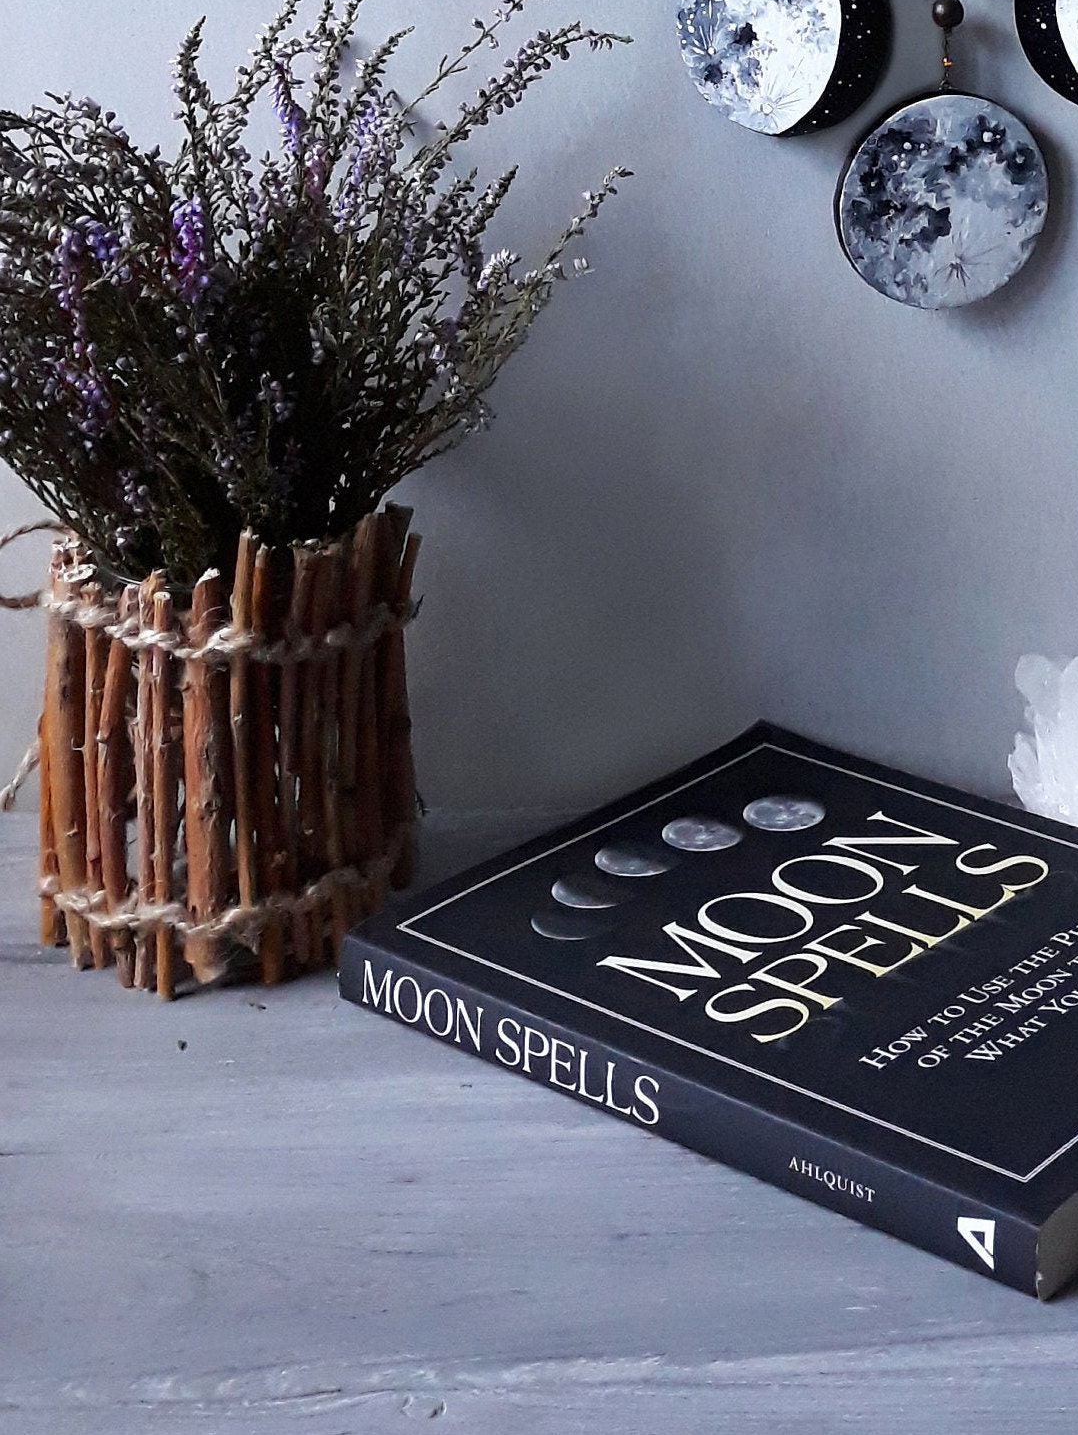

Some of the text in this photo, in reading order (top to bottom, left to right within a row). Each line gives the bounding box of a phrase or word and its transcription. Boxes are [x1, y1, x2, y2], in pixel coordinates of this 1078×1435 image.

[596, 811, 959, 1002] MOON
[705, 844, 1049, 1044] SPELLS
[362, 959, 660, 1126] MOON SPELLS
[788, 1156, 876, 1203] AHLQUIST
